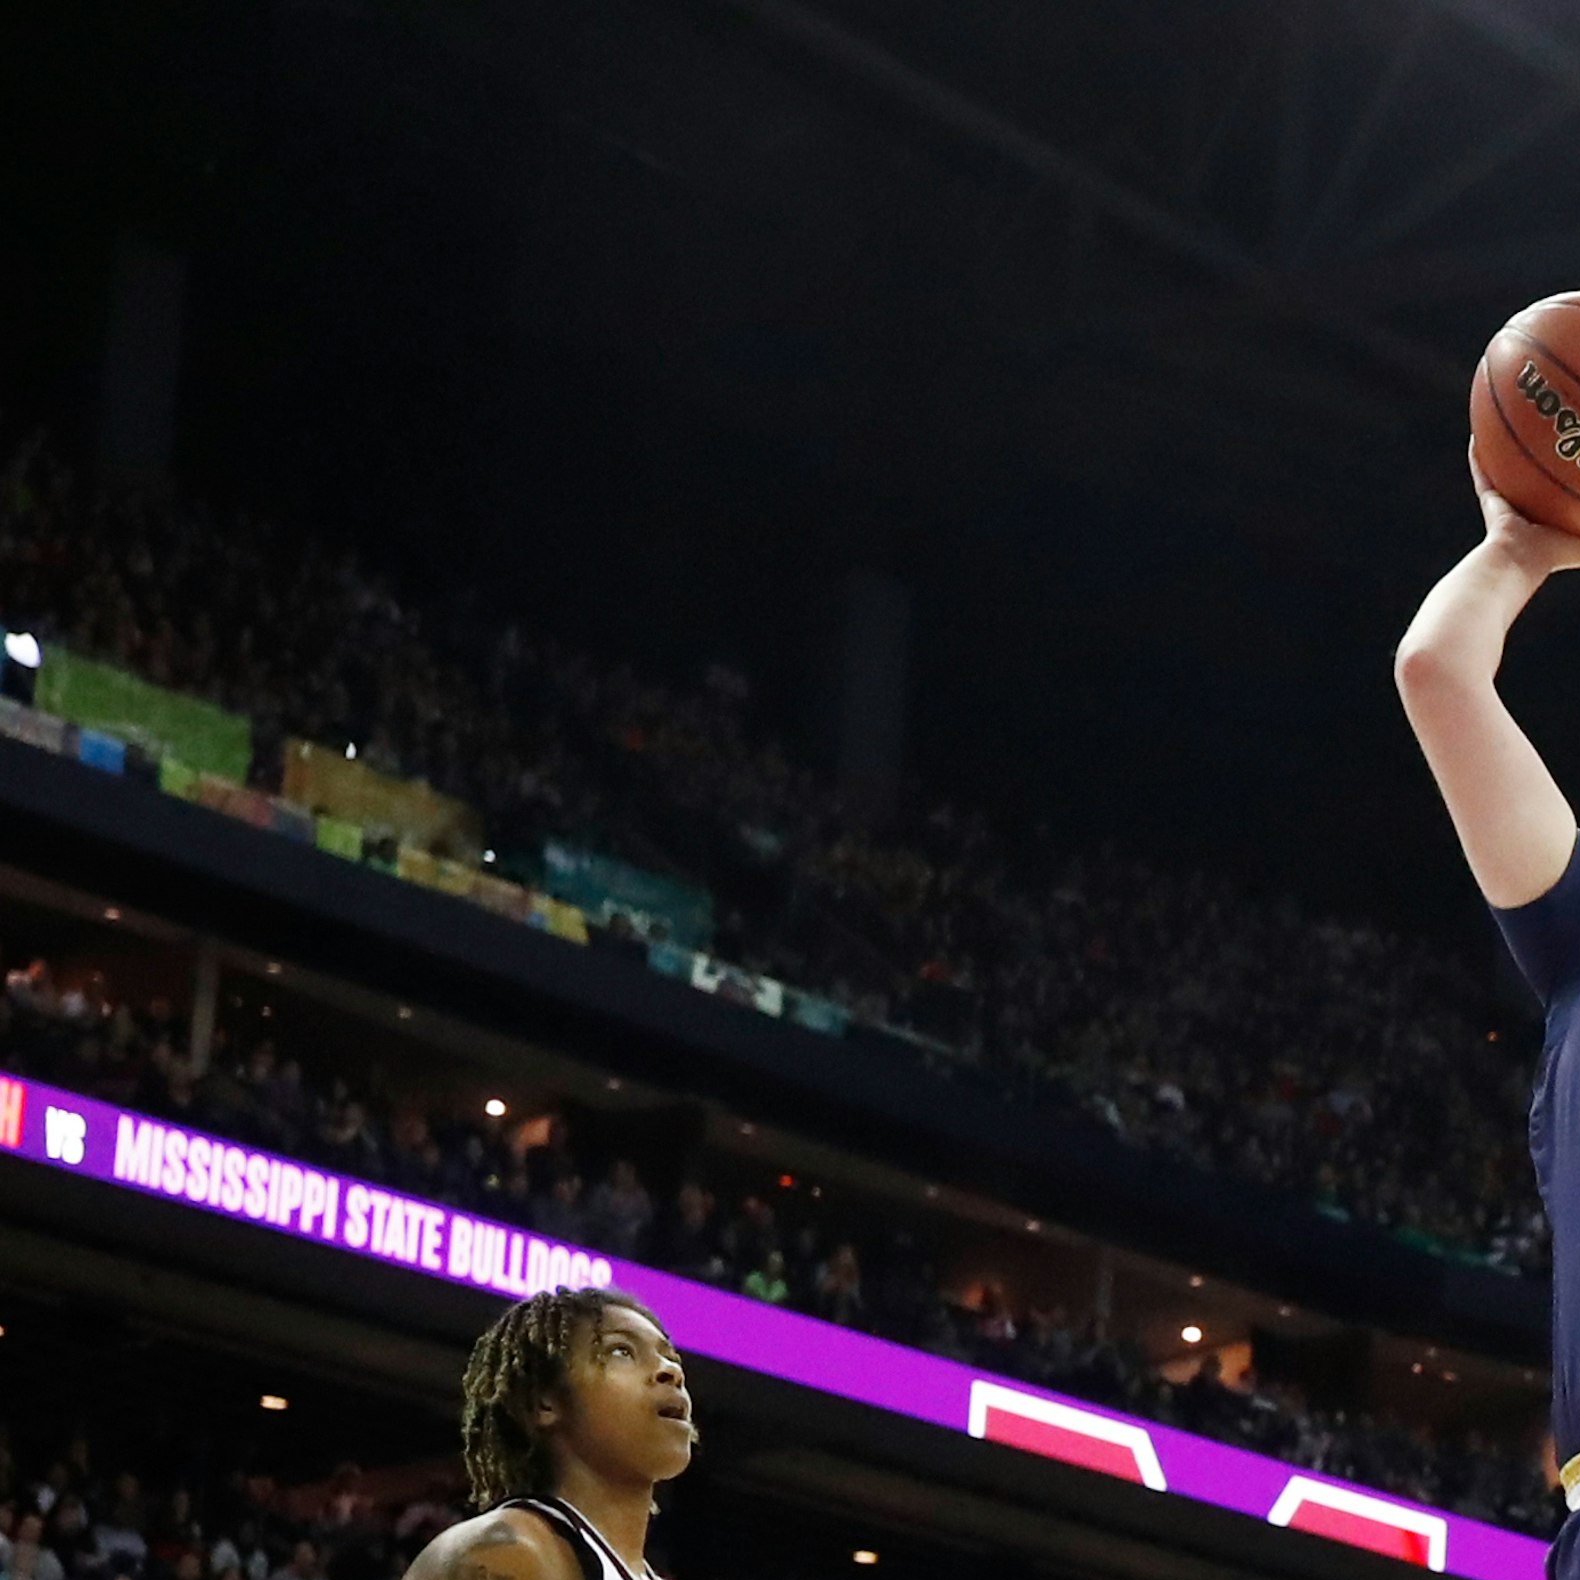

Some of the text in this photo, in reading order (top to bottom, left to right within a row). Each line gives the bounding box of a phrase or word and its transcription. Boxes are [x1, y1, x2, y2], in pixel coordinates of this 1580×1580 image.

[45, 1105, 87, 1165] VS
[113, 1113, 340, 1240] MISSISSIPPI
[344, 1183, 445, 1270] STATE
